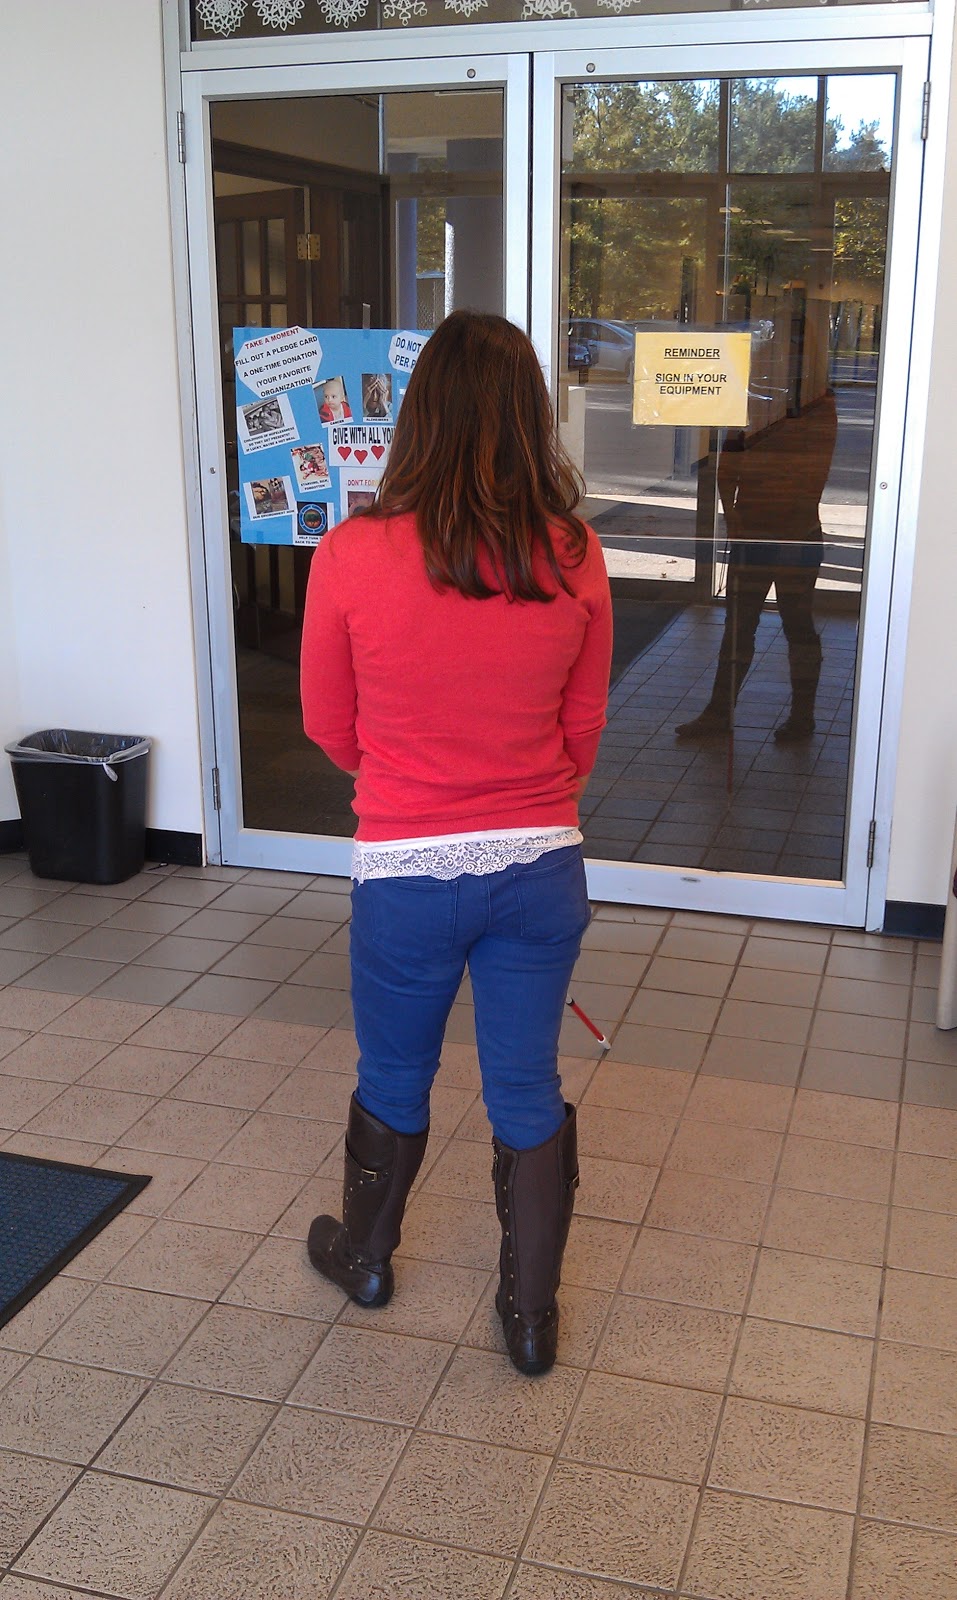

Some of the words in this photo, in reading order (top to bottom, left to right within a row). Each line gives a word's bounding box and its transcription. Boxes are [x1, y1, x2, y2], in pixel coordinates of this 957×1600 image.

[245, 339, 263, 350] TAKE
[270, 327, 300, 342] MOMENT
[396, 337, 406, 349] DO
[407, 340, 422, 354] NOT
[235, 358, 250, 366] FILL
[250, 352, 264, 362] OUT
[272, 342, 298, 355] PLEDGE
[299, 336, 318, 346] CARD
[664, 348, 720, 358] REMINDER
[250, 361, 282, 376] ONE-TIME
[282, 350, 318, 366] DONATION
[394, 354, 410, 368] PER
[256, 376, 278, 388] (YOUR
[278, 365, 312, 380] FAVORITE
[655, 373, 680, 382] SIGN
[684, 373, 694, 382] IN
[697, 374, 727, 382] YOUR
[260, 376, 314, 397] ORGANIZATION)
[660, 386, 722, 395] EQUIPMENT
[332, 427, 348, 445] GIVE
[349, 427, 367, 444] WITH
[368, 427, 381, 444] ALL
